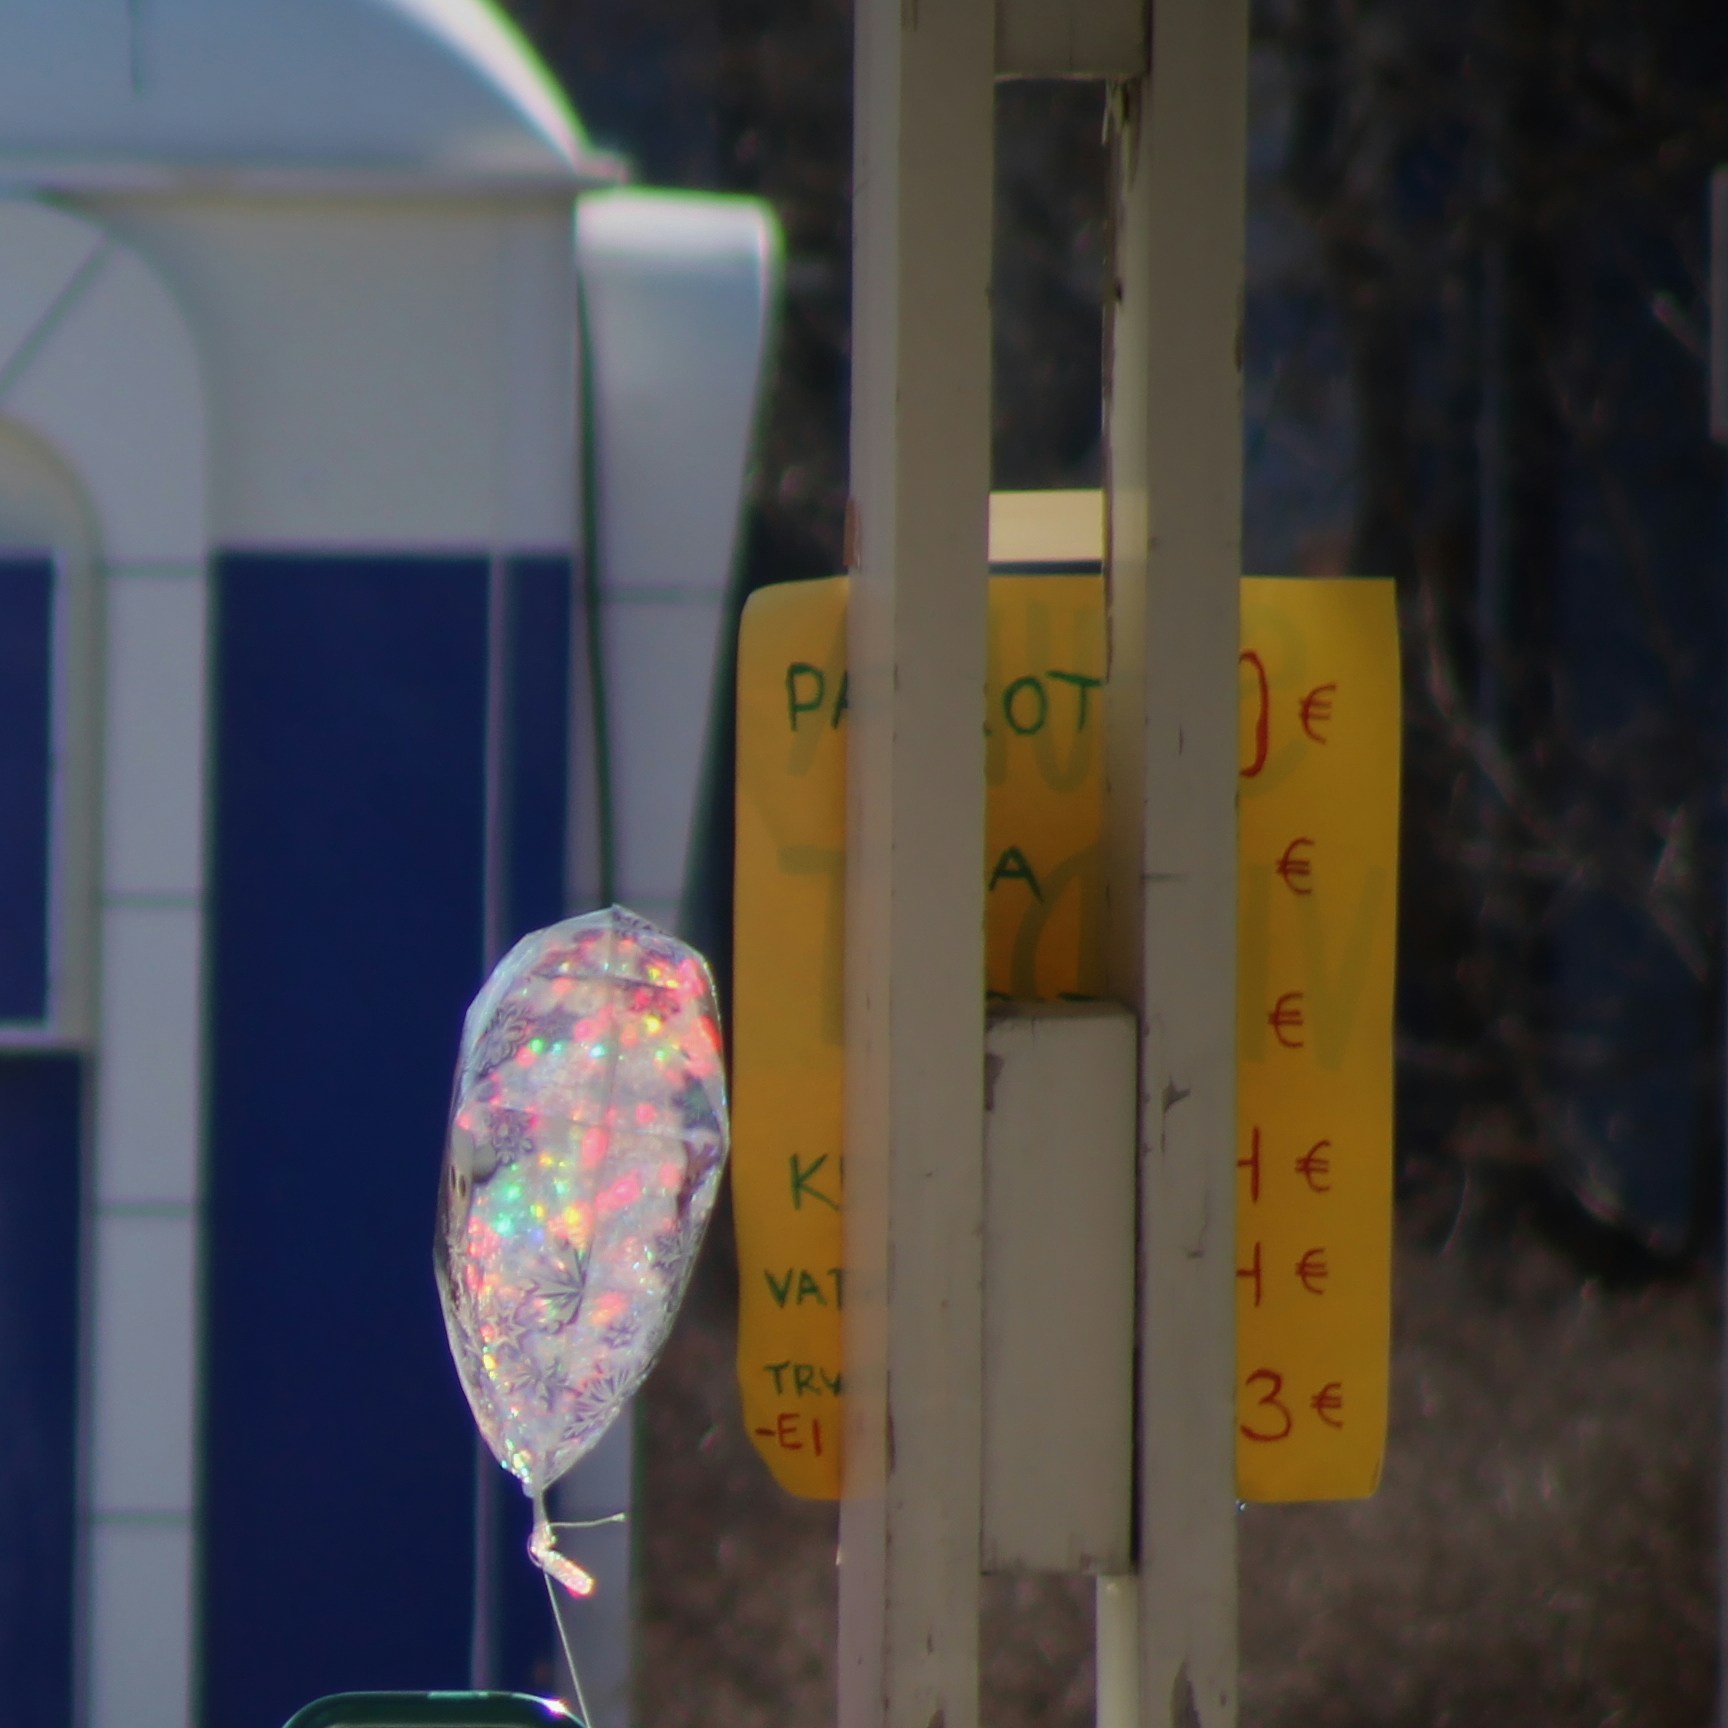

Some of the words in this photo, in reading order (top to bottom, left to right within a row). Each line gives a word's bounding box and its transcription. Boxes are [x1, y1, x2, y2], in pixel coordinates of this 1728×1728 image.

[1299, 682, 1338, 746] €
[1276, 836, 1316, 896] €
[1268, 991, 1304, 1050] €
[1294, 1138, 1332, 1194] €
[1295, 1247, 1329, 1296] €
[1239, 1369, 1292, 1443] 3
[1310, 1382, 1344, 1429] €
